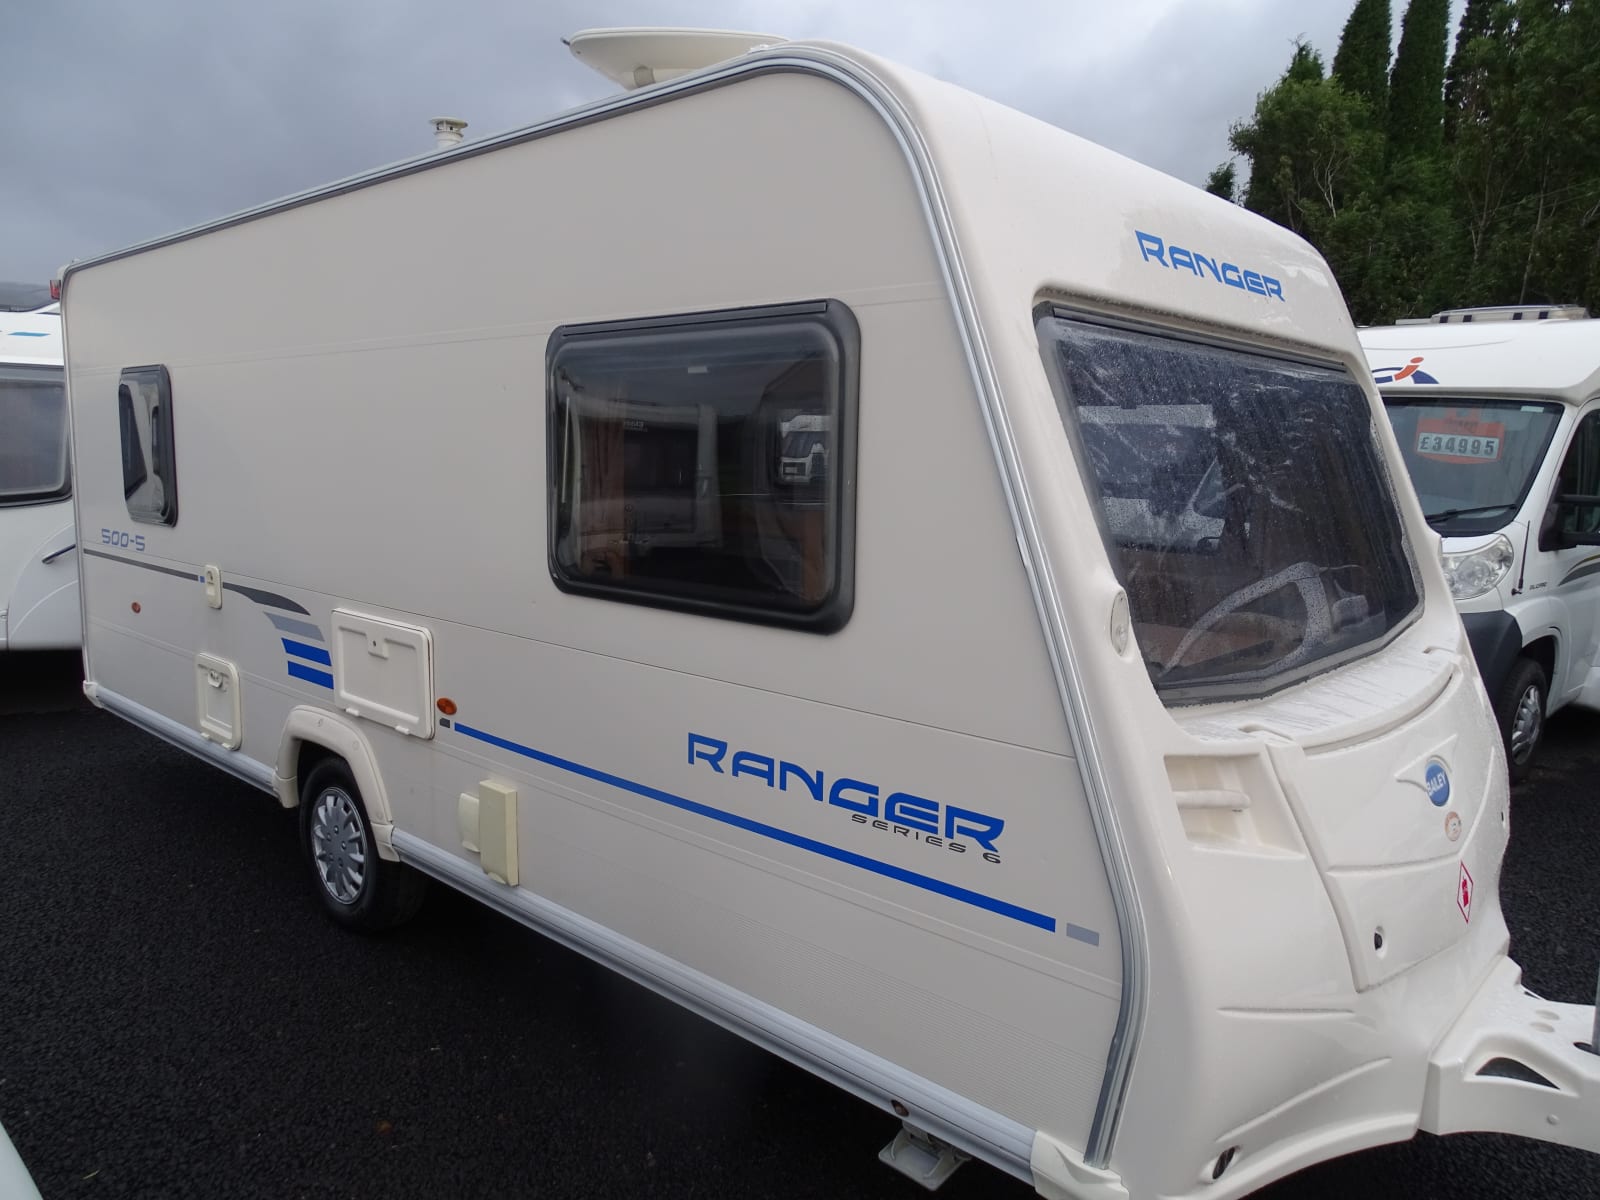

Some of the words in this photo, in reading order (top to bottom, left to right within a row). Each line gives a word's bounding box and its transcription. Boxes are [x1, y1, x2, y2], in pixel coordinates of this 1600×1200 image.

[1135, 230, 1286, 302] RANGER
[1419, 436, 1495, 455] £34995
[687, 732, 1005, 853] RANGER
[851, 813, 967, 854] SERIES
[982, 851, 1002, 864] 6
